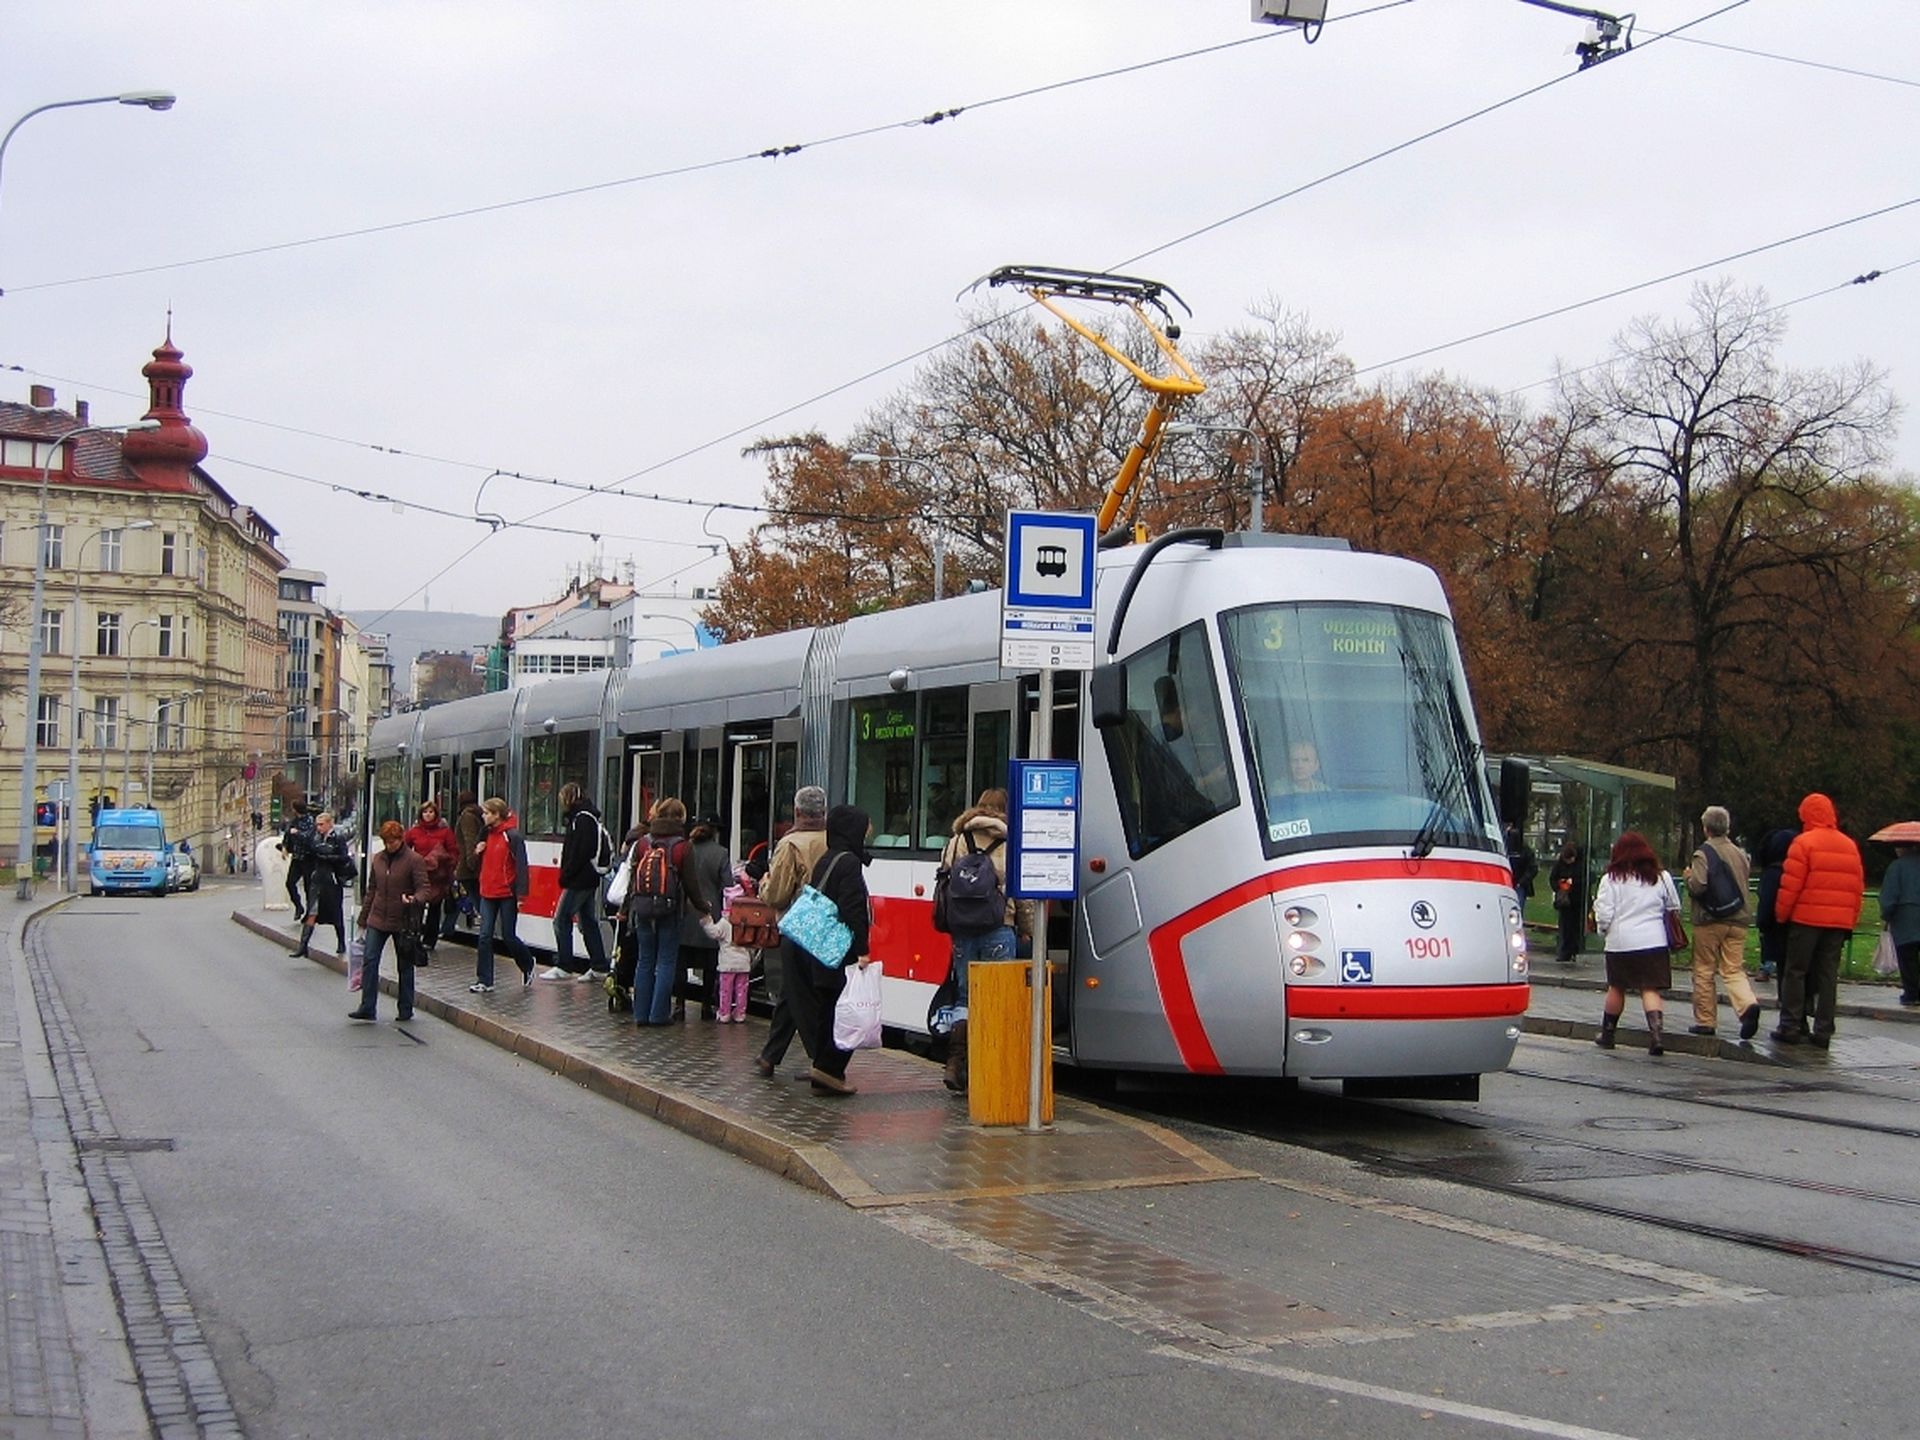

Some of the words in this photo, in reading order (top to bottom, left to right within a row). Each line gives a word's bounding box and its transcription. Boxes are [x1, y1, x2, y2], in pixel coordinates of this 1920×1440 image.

[1263, 613, 1283, 650] 3
[862, 712, 871, 741] 3
[1404, 937, 1451, 959] 1901
